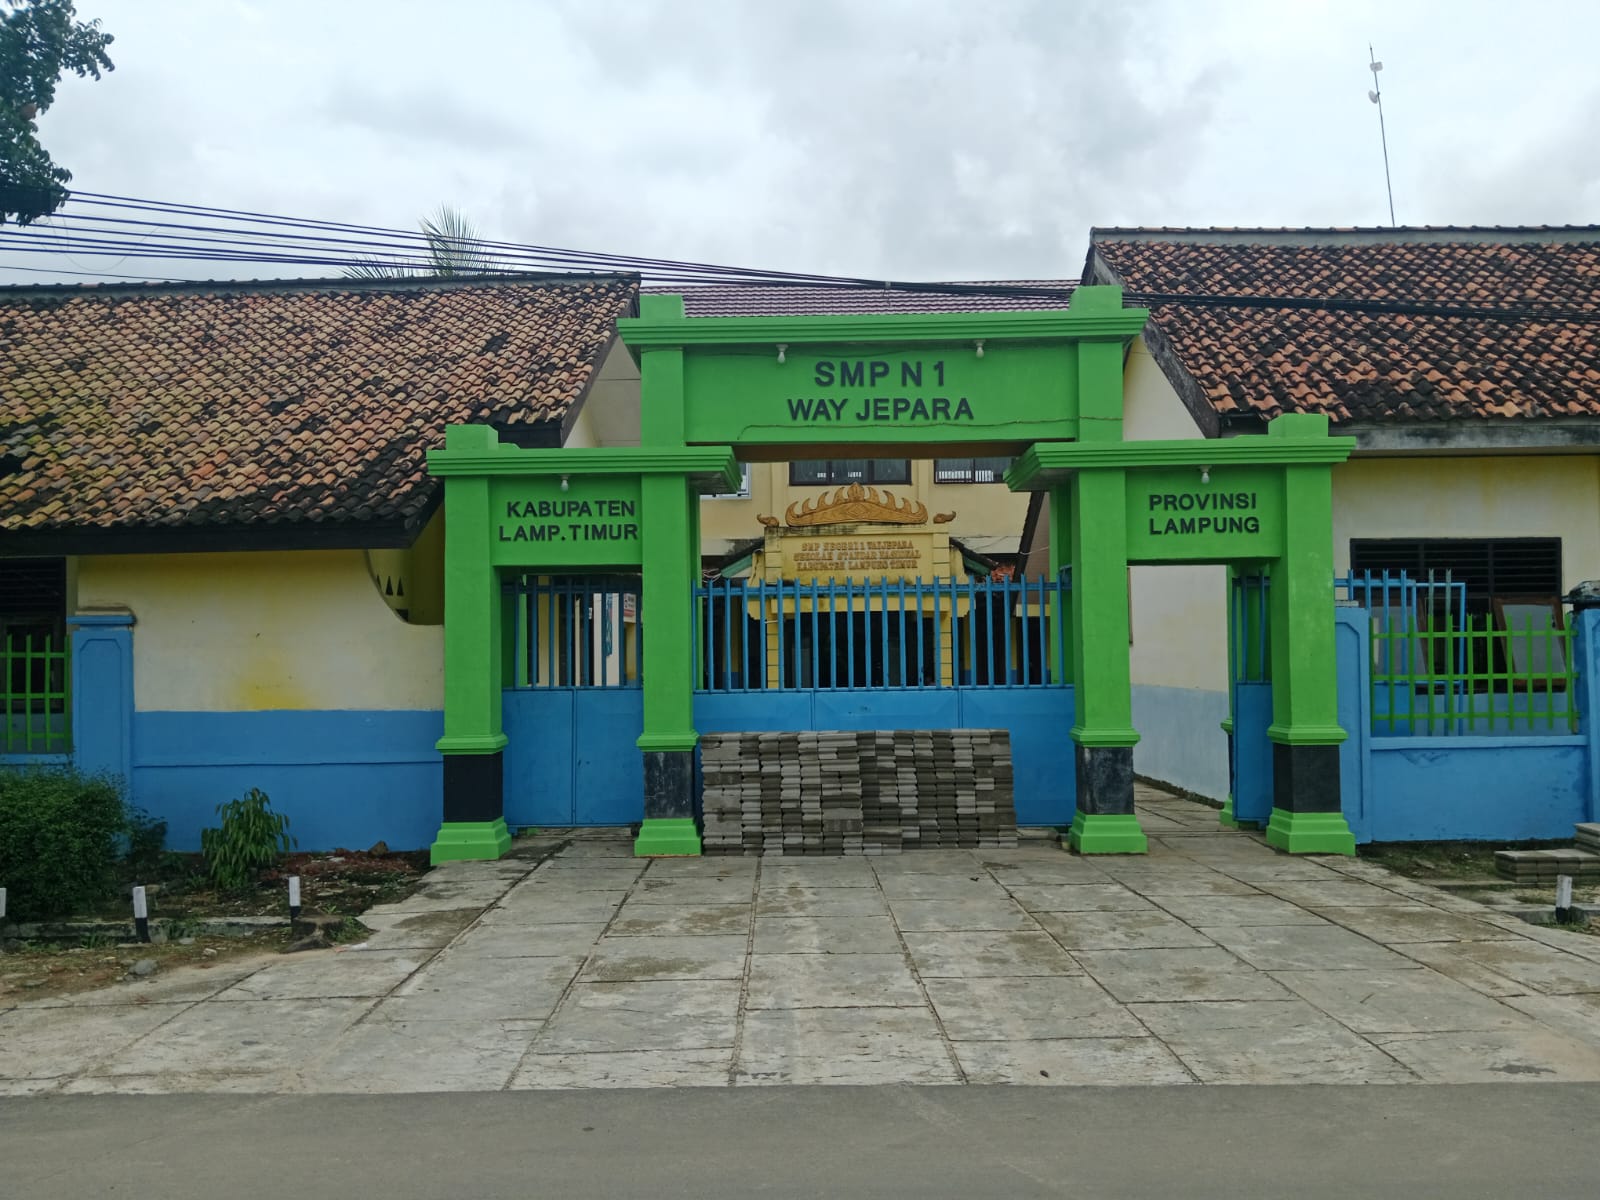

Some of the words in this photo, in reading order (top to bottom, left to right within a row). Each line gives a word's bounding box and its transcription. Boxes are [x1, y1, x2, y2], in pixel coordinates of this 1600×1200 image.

[815, 360, 890, 386] SMP
[901, 361, 923, 386] N
[935, 360, 946, 385] 1
[788, 398, 846, 420] WAY
[856, 397, 974, 420] JEPARA
[507, 500, 636, 518] KABUPATEN
[1149, 493, 1256, 510] PROVINSI
[1150, 516, 1259, 534] LAMPUNG
